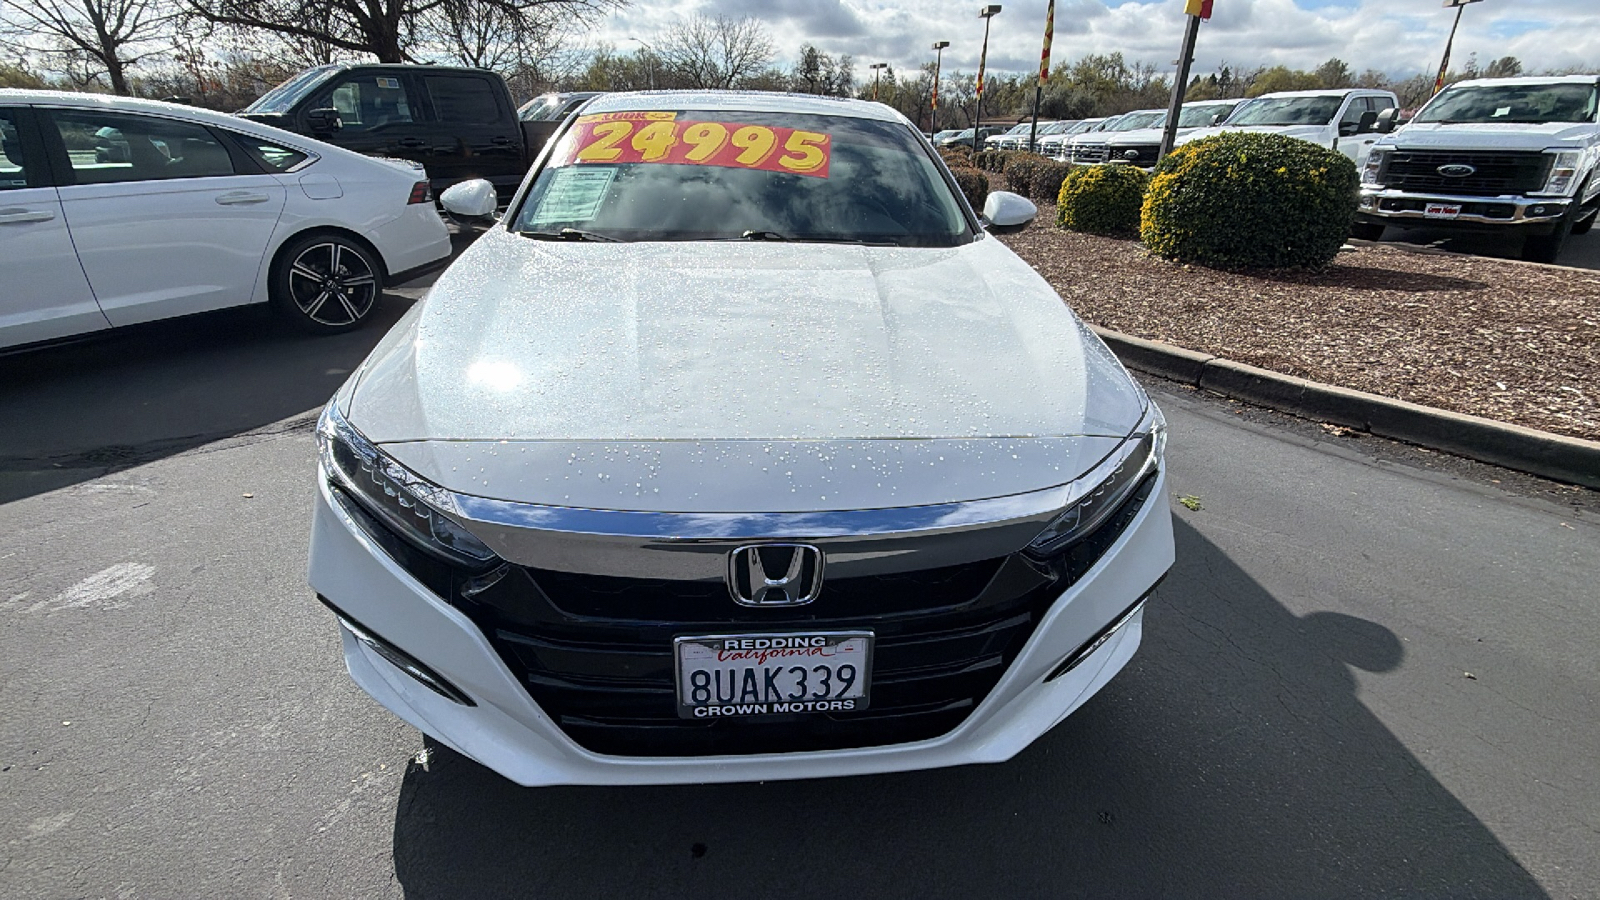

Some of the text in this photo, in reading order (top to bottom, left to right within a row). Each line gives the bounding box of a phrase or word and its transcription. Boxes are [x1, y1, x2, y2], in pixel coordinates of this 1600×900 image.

[724, 636, 826, 650] REDDING
[718, 647, 836, 665] California
[690, 664, 857, 705] 8UAK339
[694, 700, 855, 717] CROWN MOTORS
